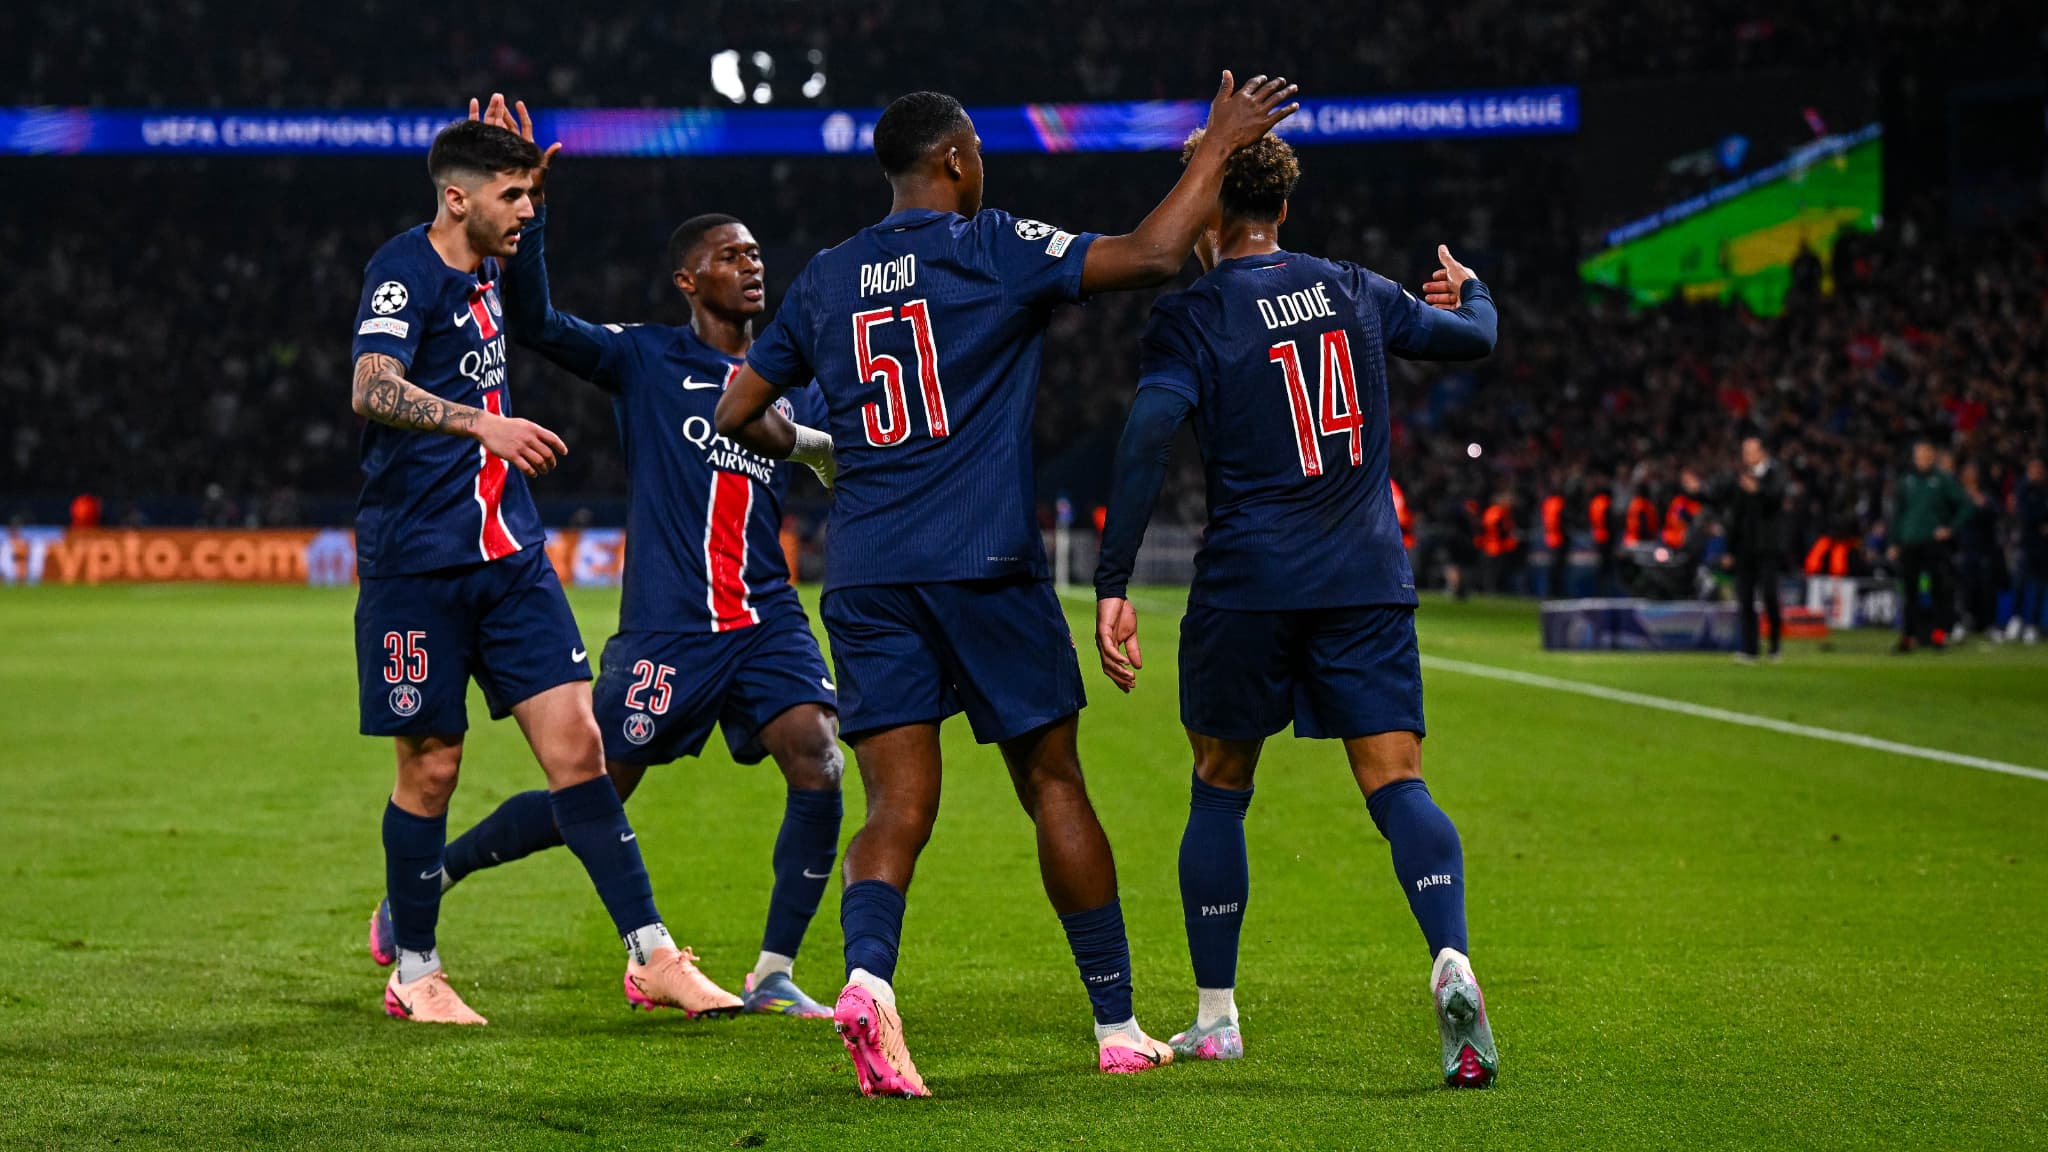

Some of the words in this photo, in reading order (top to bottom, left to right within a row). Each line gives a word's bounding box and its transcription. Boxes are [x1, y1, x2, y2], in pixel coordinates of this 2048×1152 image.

[142, 118, 217, 146] UEFA
[221, 118, 394, 147] CHAMPIONS
[1317, 99, 1467, 134] CHAMPIONS
[1468, 95, 1562, 128] LEAGUE
[861, 254, 915, 297] PACHO
[1257, 281, 1336, 329] D.DOUÉ
[460, 334, 506, 382] QATA
[852, 299, 949, 447] 51
[1268, 329, 1364, 477] 14
[706, 449, 773, 484] AIRWAYS
[383, 630, 428, 684] 35
[625, 659, 676, 715] 25
[1416, 874, 1452, 892] PARIS
[1201, 902, 1239, 917] PARIS
